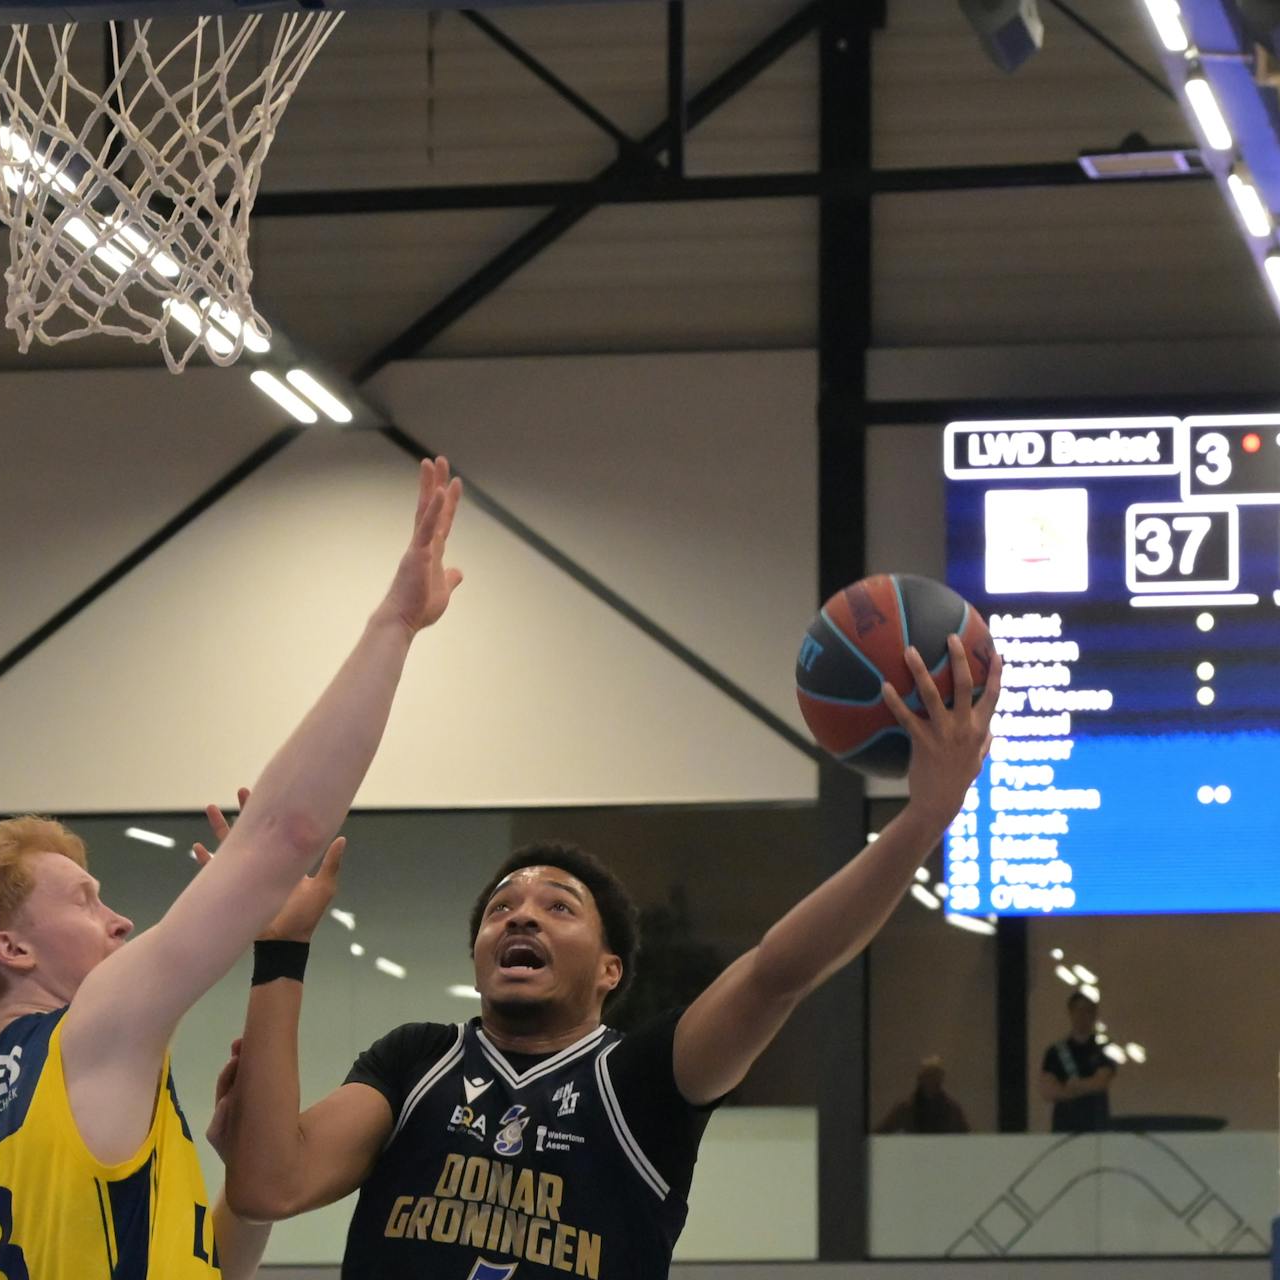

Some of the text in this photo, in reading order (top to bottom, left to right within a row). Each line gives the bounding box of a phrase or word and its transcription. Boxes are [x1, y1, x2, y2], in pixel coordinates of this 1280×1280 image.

[968, 431, 1045, 466] LWD
[1195, 432, 1232, 485] 3
[1134, 517, 1211, 575] 37
[434, 1153, 564, 1222] DONAR
[384, 1195, 602, 1280] GRONINGEN
